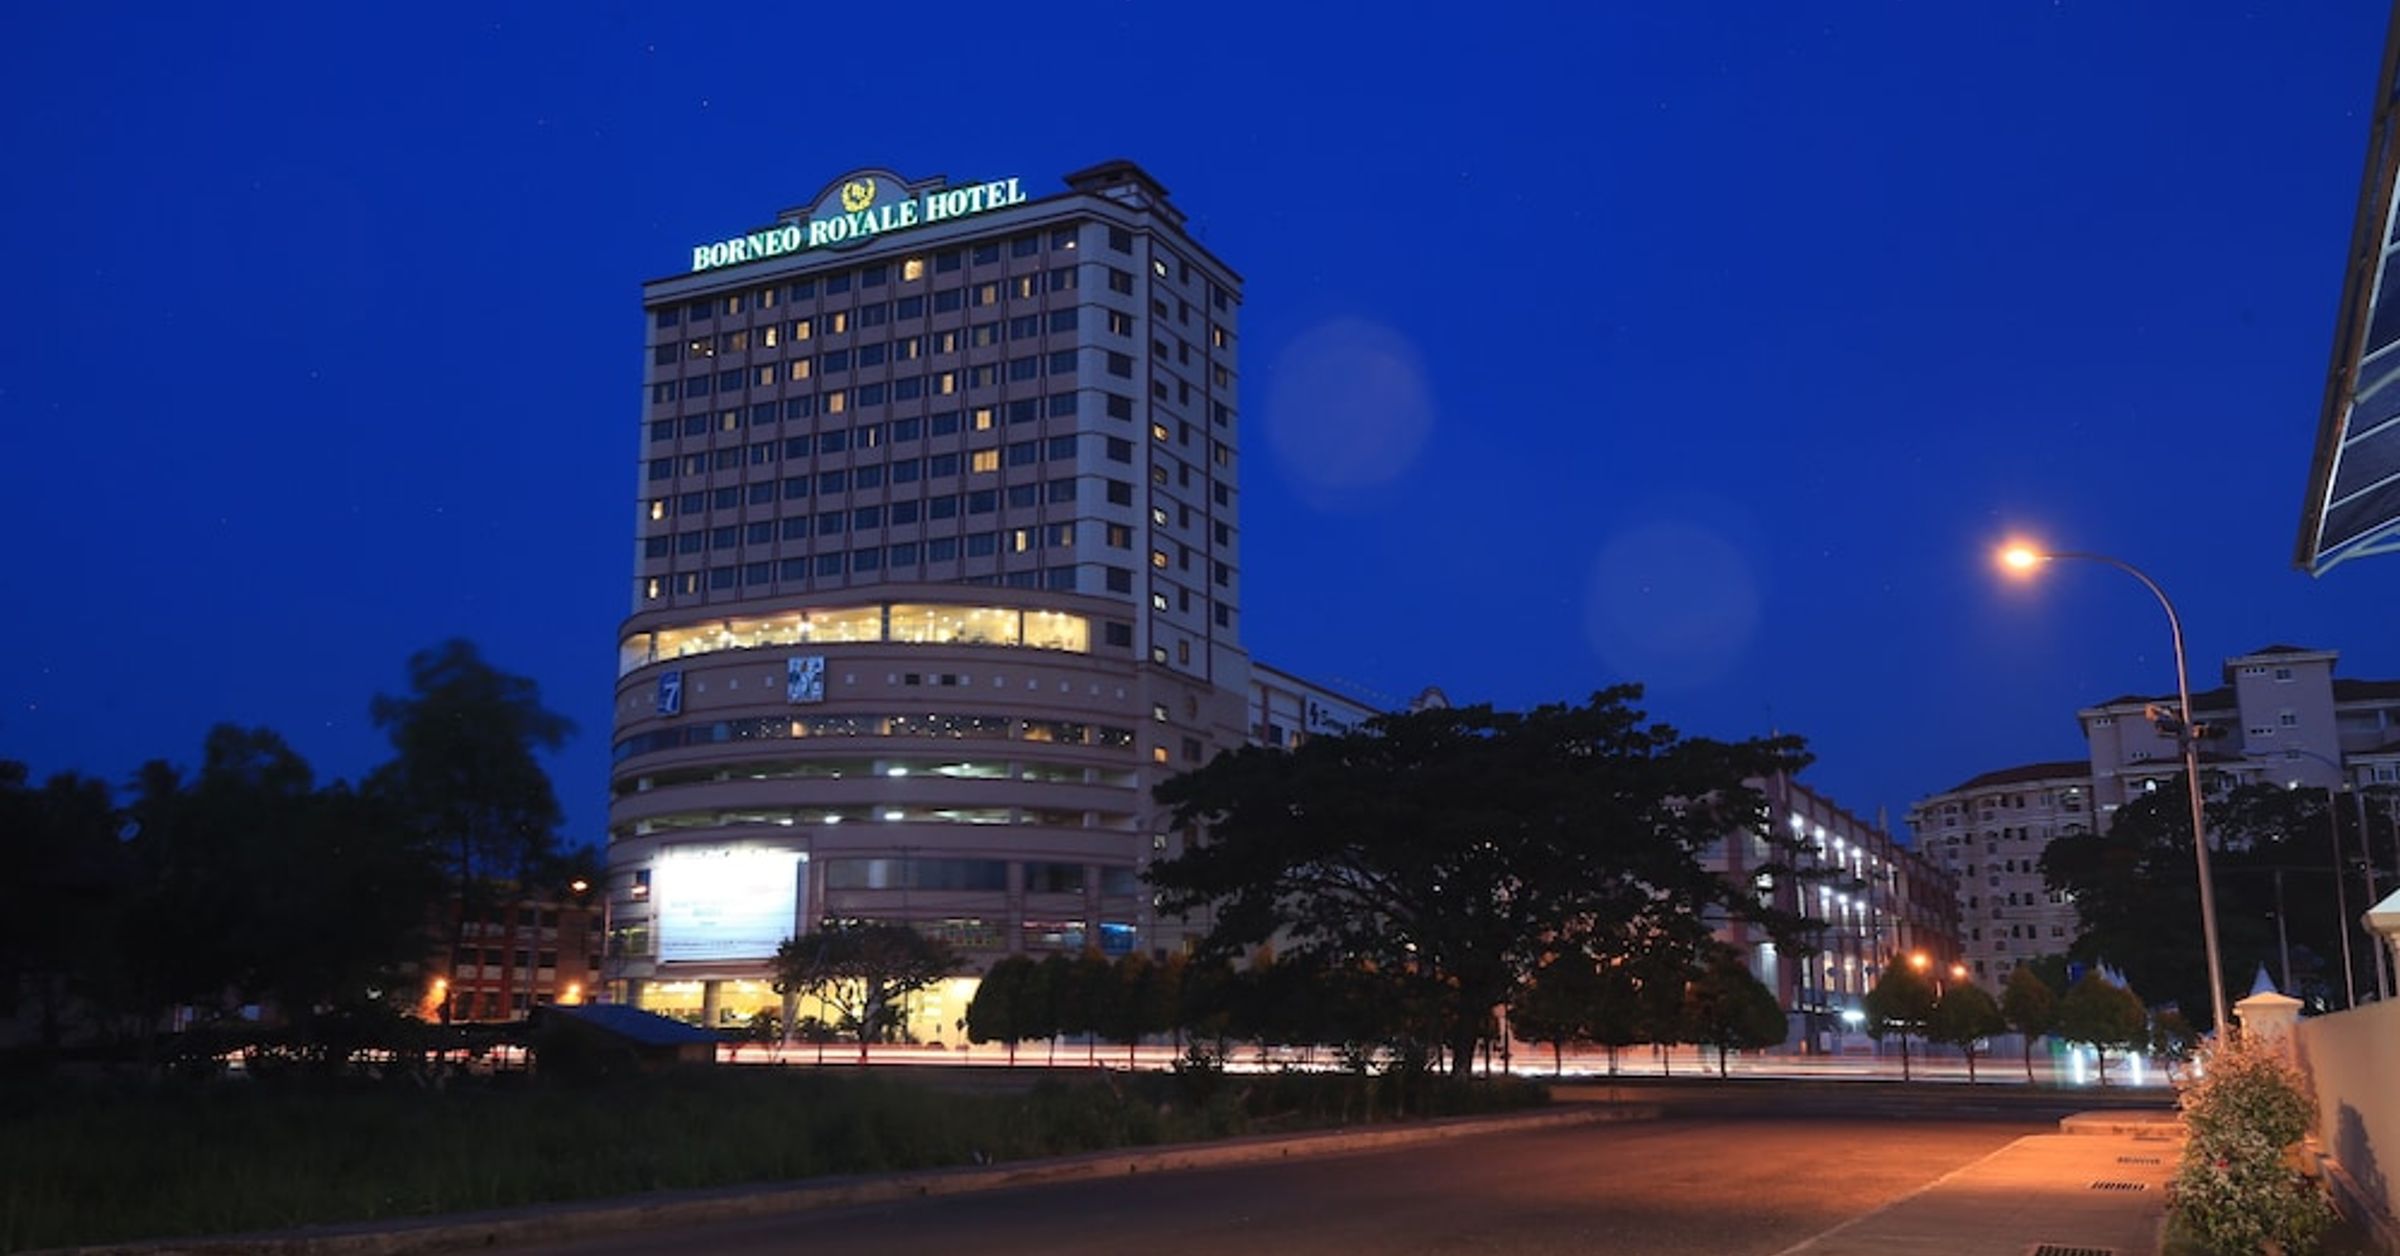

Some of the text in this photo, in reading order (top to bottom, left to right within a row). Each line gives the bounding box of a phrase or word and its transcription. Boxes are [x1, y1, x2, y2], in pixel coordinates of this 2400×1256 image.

[692, 177, 1026, 272] BORNEO ROYALE HOTEL
